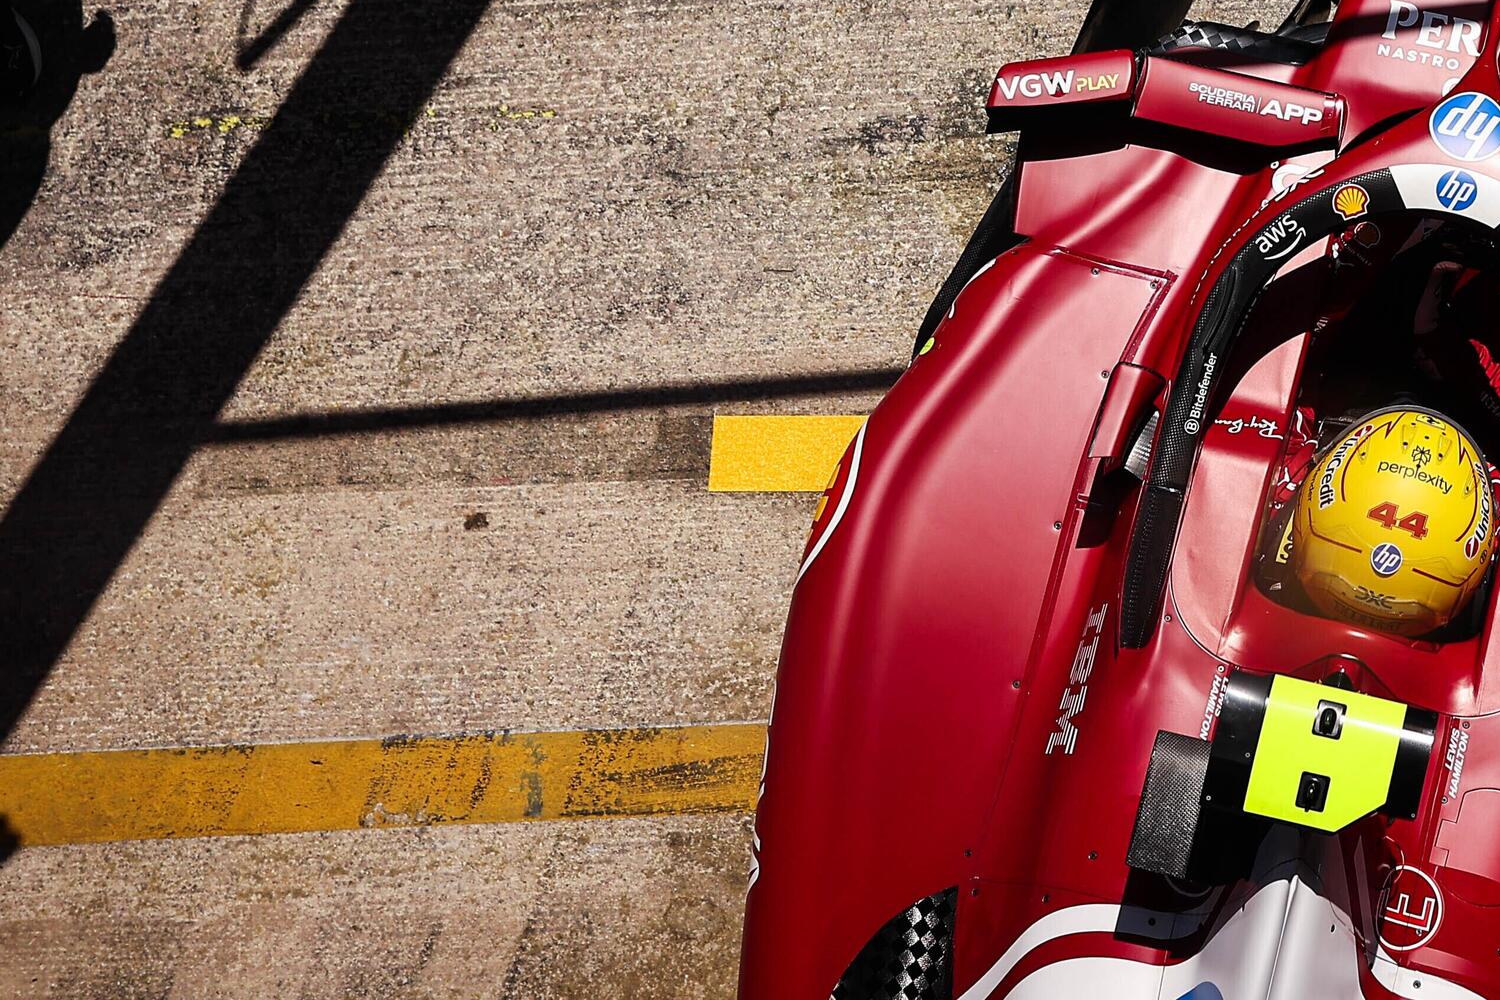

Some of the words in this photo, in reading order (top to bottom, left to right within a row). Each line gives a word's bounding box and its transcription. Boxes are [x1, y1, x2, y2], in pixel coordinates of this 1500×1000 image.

[1378, 44, 1461, 70] NASTRO
[998, 70, 1075, 100] VGW
[1076, 73, 1119, 92] PLAY
[1189, 82, 1256, 103] SCUDERIA
[1199, 93, 1255, 113] FERRARI
[1260, 99, 1323, 125] APP
[1437, 170, 1476, 210] hp
[1255, 214, 1299, 255] aws
[1189, 352, 1218, 420] Bitdefender
[1214, 417, 1284, 441] Ray-Ban
[1318, 433, 1359, 511] UniCredit
[1377, 458, 1454, 494] perplexity
[1367, 501, 1429, 540] 44
[1373, 544, 1402, 575] hp
[1046, 603, 1107, 755] IBM
[1212, 676, 1230, 720] LEWIS
[1200, 674, 1222, 741] HAMILTON
[1444, 728, 1460, 770] LEWIS
[1447, 731, 1469, 799] HAMILTON
